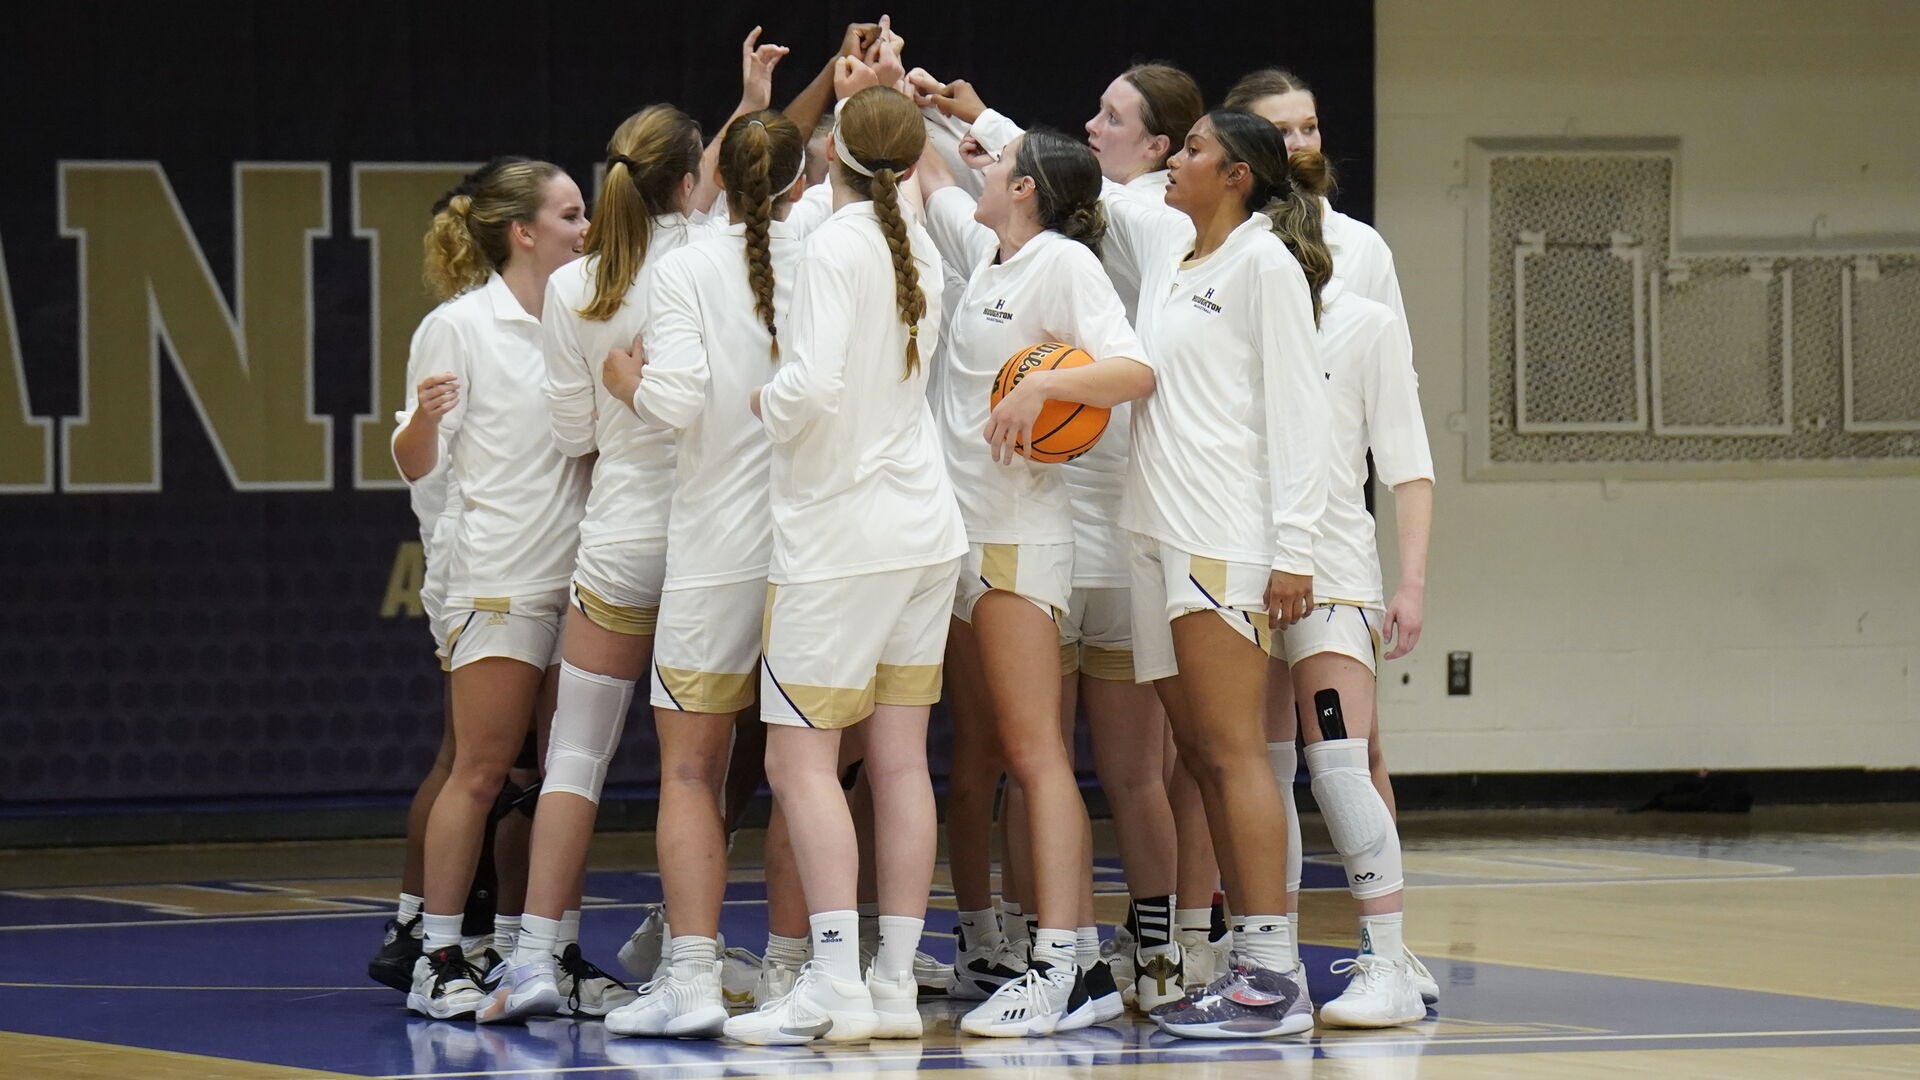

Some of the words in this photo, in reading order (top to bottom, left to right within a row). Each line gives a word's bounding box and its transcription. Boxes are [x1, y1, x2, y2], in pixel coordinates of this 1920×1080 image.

[1205, 287, 1215, 299] H
[995, 299, 1006, 310] H
[1009, 342, 1065, 392] Wilso
[1323, 707, 1334, 717] KT
